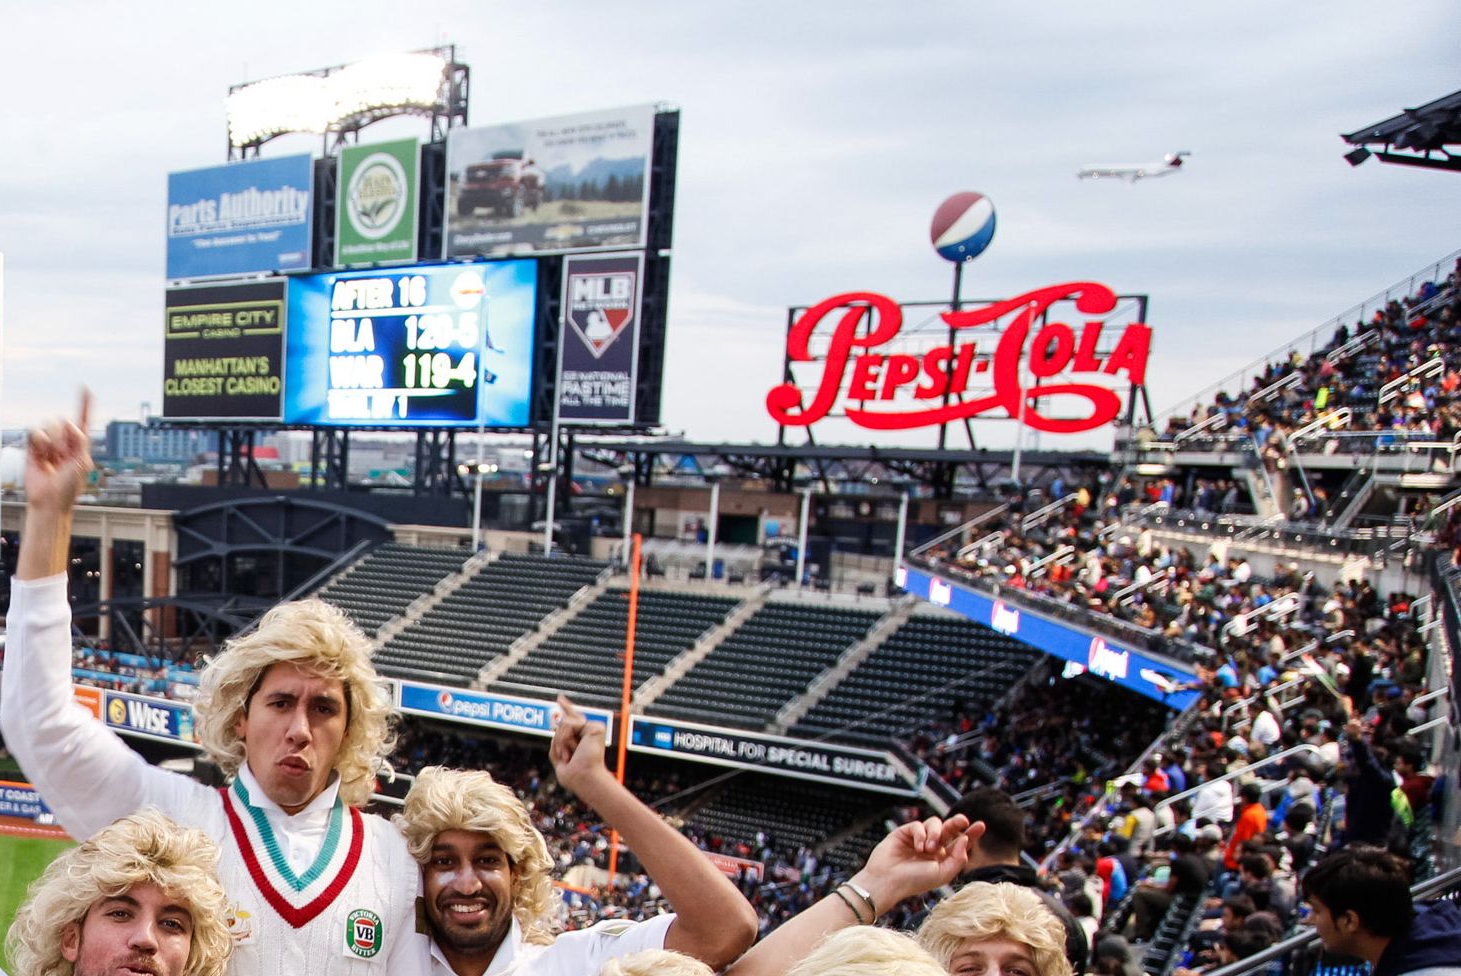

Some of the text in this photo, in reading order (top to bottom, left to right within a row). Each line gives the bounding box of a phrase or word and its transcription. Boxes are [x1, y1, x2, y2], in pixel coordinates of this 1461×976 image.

[169, 184, 309, 227] Parts Authority
[331, 275, 427, 311] AFTER 16
[573, 277, 630, 301] MLB
[170, 309, 275, 329] EMPIRE CITY
[201, 327, 241, 339] CASINO
[174, 355, 270, 376] MANHATTAN'S
[165, 375, 281, 396] CLOSEST CASINO
[562, 380, 630, 395] PASTIME
[127, 700, 171, 735] WISE
[452, 697, 544, 727] pepsi PORCH
[673, 732, 737, 756] HOSPITAL
[739, 742, 767, 760] FOR
[767, 747, 831, 772] SPECIAL
[5, 789, 41, 802] COAST
[349, 910, 380, 926] VICTORIA
[356, 925, 374, 941] VB
[351, 943, 377, 957] BITTER
